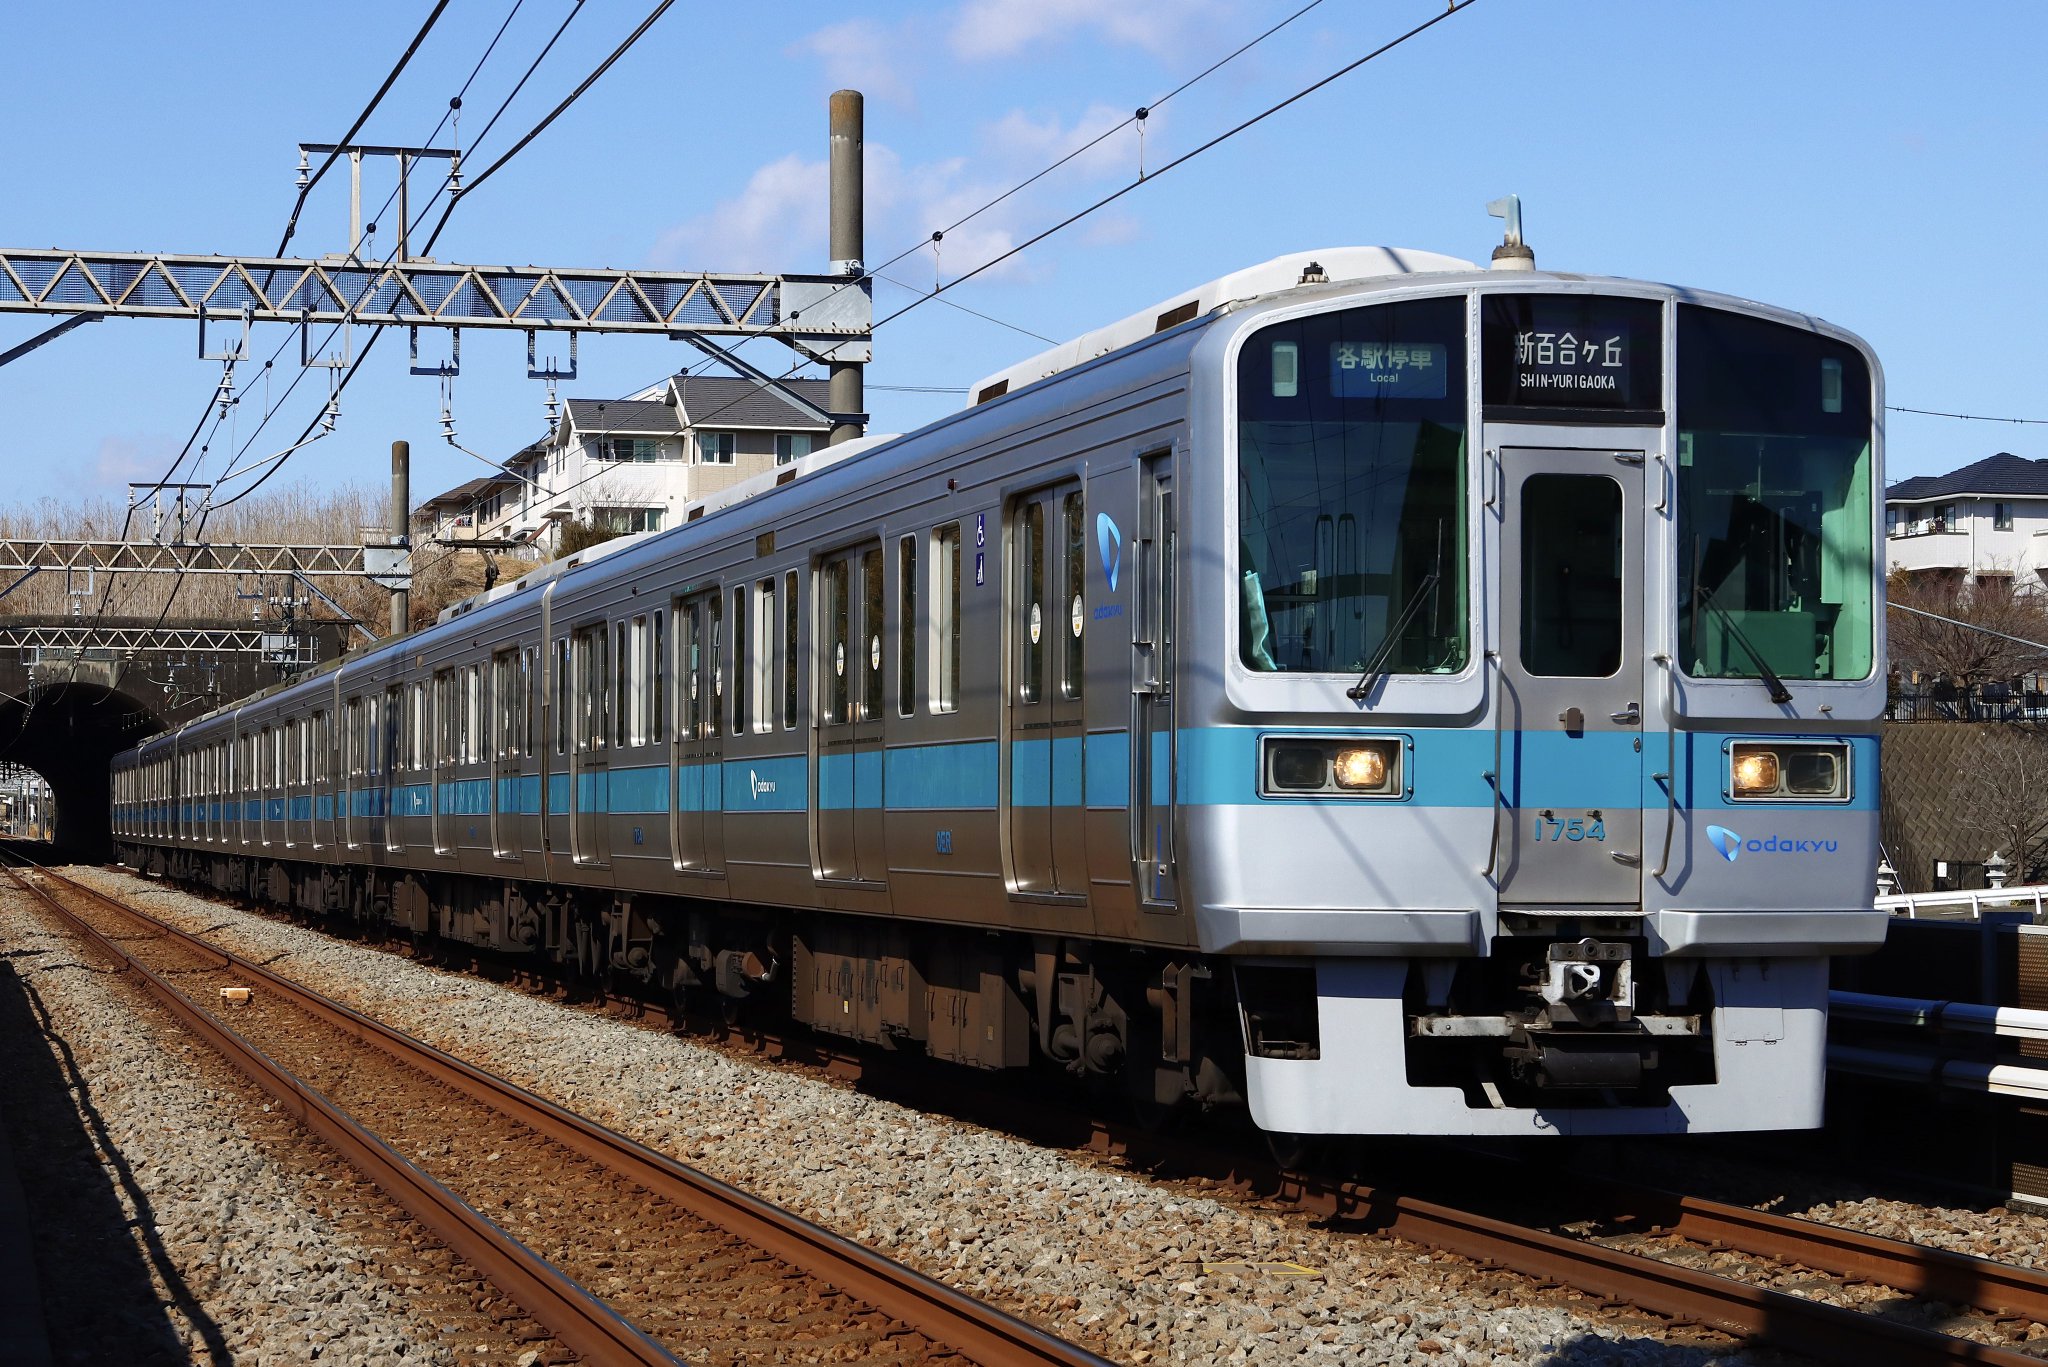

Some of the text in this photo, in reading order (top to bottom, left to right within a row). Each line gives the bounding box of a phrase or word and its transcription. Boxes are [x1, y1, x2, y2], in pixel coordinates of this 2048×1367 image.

[1337, 343, 1433, 370] 各駅停車
[1370, 373, 1399, 383] Local
[1520, 373, 1616, 389] SHIN-YURIGAOKA
[1535, 817, 1606, 842] 1754
[1746, 834, 1838, 853] odakyu
